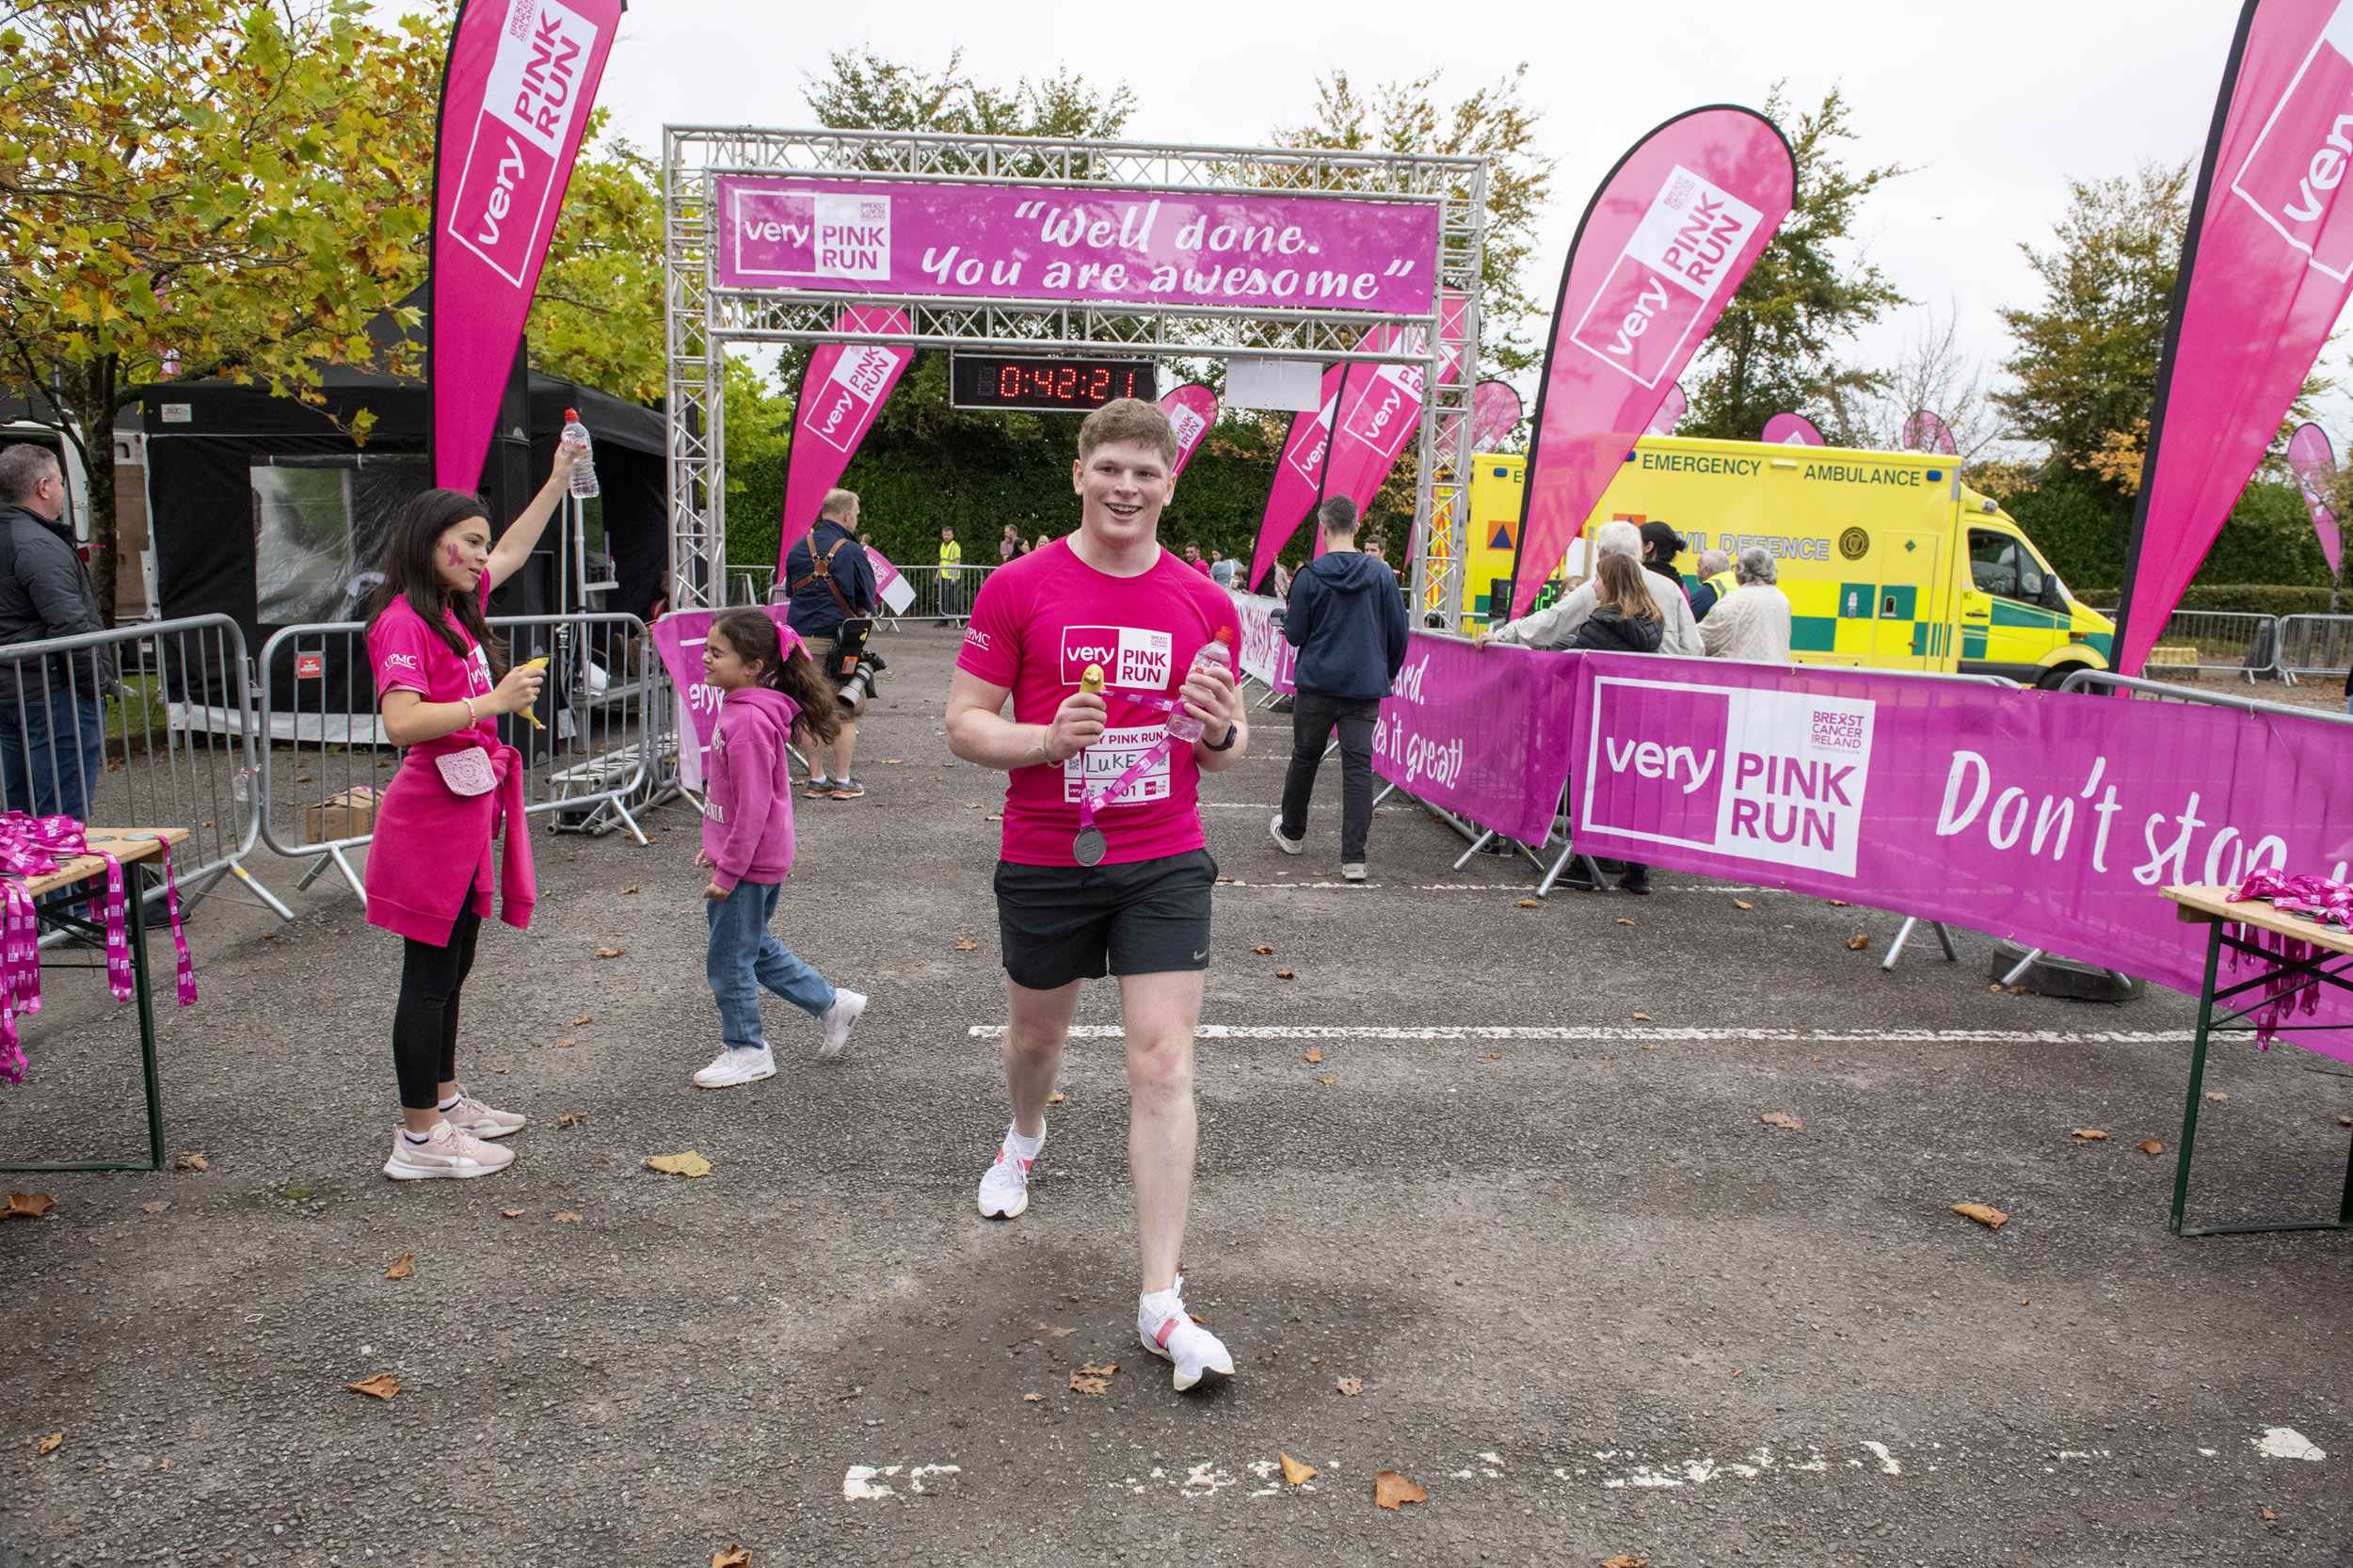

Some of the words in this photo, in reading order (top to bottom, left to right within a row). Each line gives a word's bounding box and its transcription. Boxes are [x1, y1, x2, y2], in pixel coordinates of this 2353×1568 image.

[514, 8, 563, 124] PINK
[536, 35, 581, 140] RUN
[2283, 92, 2353, 222] ver
[478, 136, 525, 245] very
[744, 221, 809, 248] very
[823, 226, 886, 248] PINK
[1175, 214, 1320, 255] done.
[1661, 191, 1725, 272] PINK
[1685, 214, 1743, 286] RUN
[823, 248, 877, 270] RUN
[921, 246, 1022, 285] You
[1043, 258, 1130, 292] are
[1607, 277, 1669, 355] very
[849, 346, 881, 389] PINK
[860, 358, 889, 397] RUN
[1000, 366, 1133, 399] 0:42:21
[822, 390, 853, 434] very
[1175, 414, 1194, 440] PINK
[1364, 388, 1401, 439] very
[1181, 421, 1200, 446] RUN
[1302, 434, 1329, 472] ver
[1642, 454, 1762, 476] EMERGENCY
[1803, 464, 1921, 487] AMBULANCE
[1675, 532, 1708, 553] VIL
[1720, 534, 1831, 561] DEFENCE
[384, 653, 417, 667] UPMC
[1066, 646, 1115, 665] very
[1122, 665, 1161, 683] RUN
[1123, 649, 1167, 667] PINK
[1391, 653, 1430, 705] ard.
[1109, 734, 1139, 744] PINK
[1141, 731, 1163, 743] RUN
[1390, 712, 1403, 764] it
[1811, 734, 1862, 748] IRELAND
[1812, 723, 1863, 739] CANCER
[1606, 737, 1717, 794] very
[1735, 751, 1857, 808] PINK
[1103, 785, 1136, 797] 101
[1730, 797, 1835, 852] RUN
